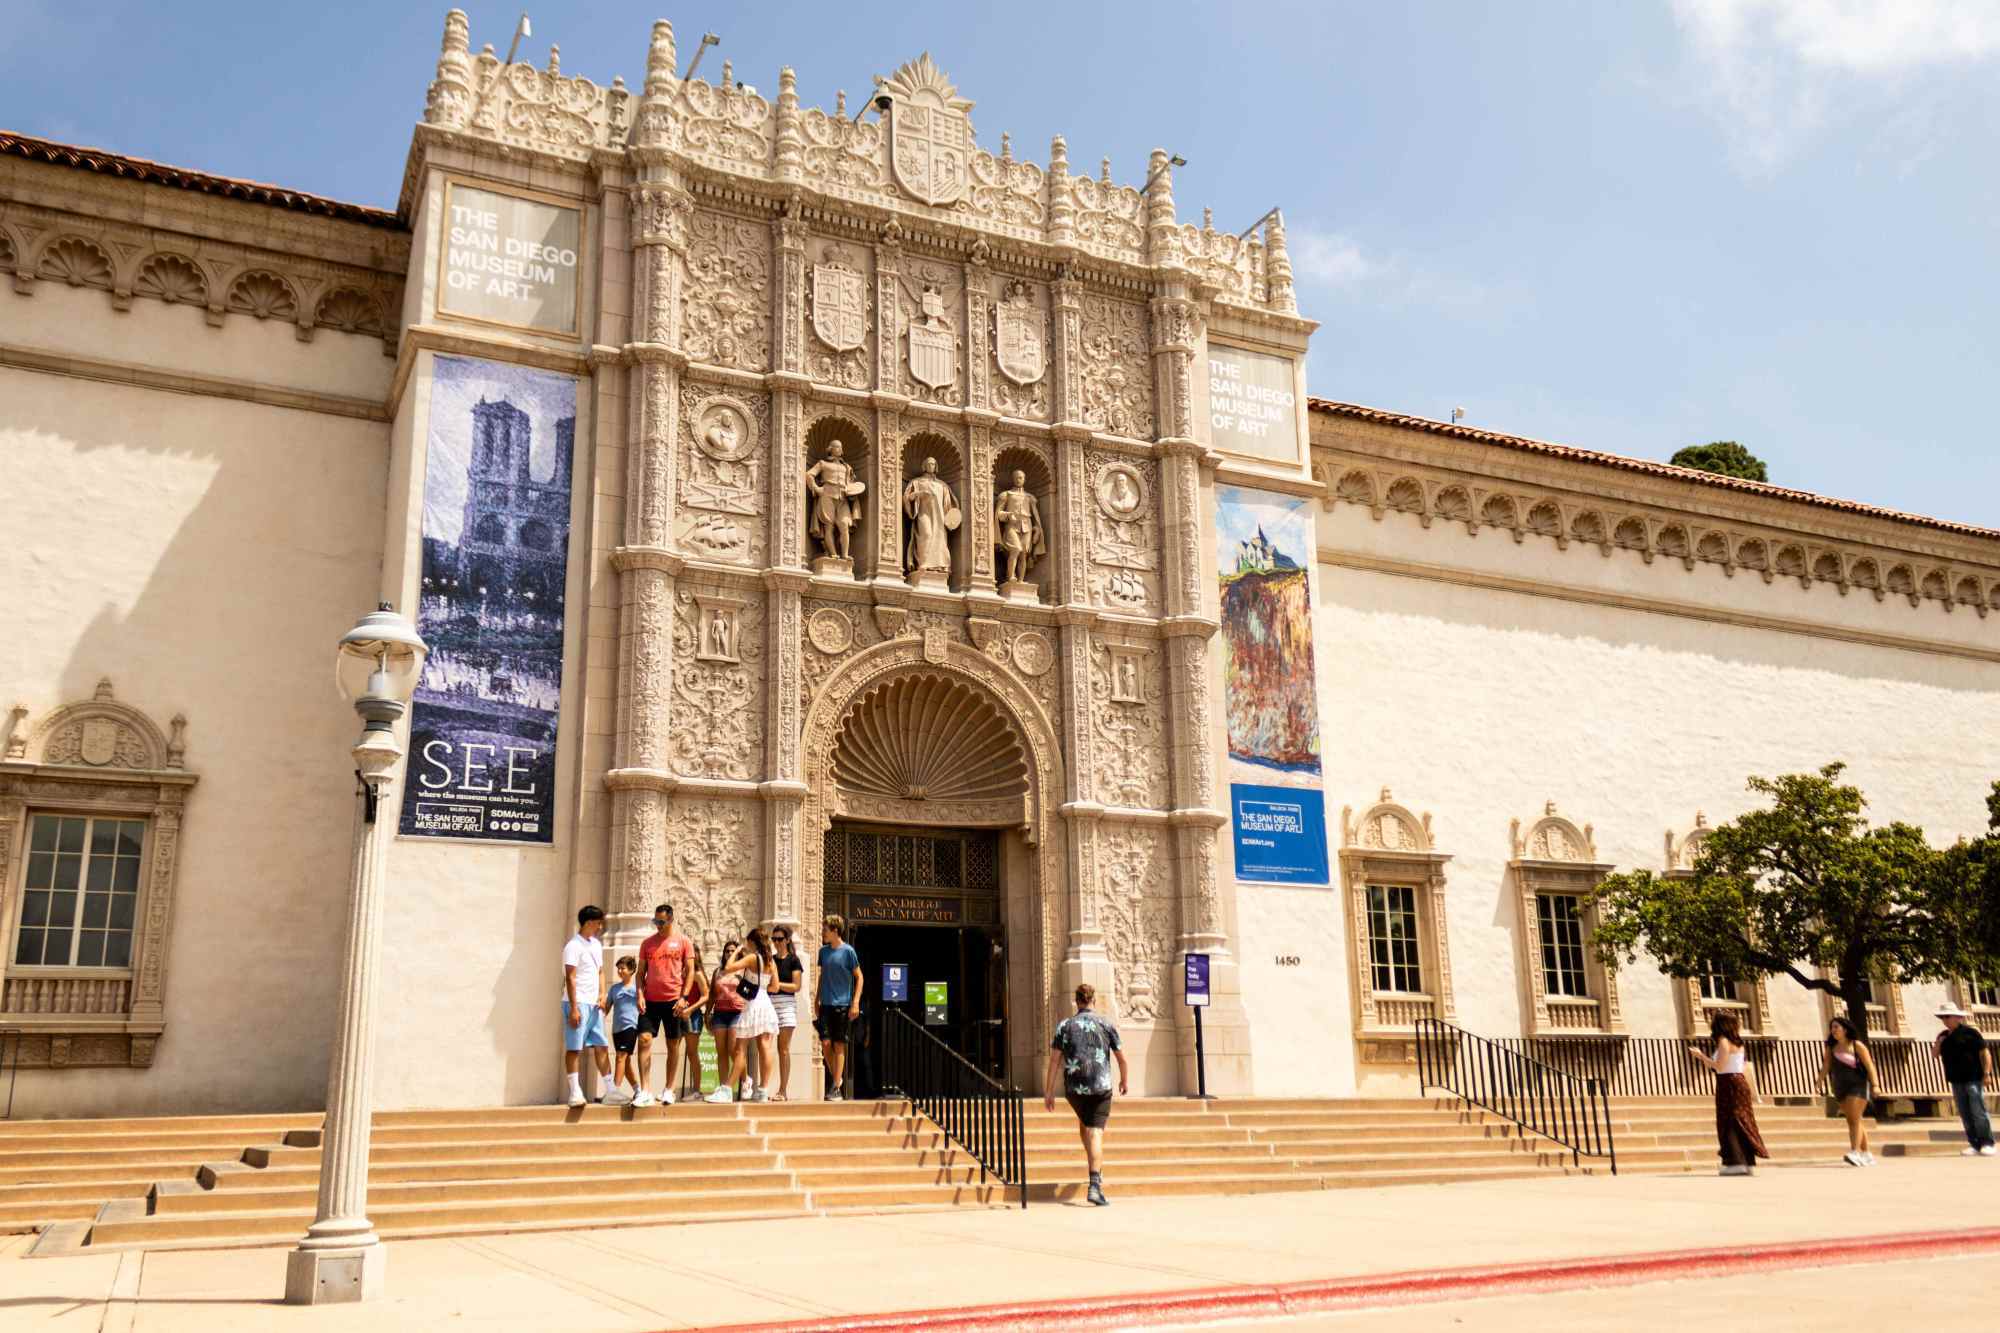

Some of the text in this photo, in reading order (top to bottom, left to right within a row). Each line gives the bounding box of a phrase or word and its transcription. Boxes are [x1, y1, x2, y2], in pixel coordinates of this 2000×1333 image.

[451, 205, 498, 230] THE
[450, 227, 577, 267] SAN DIEGO
[449, 249, 555, 285] MUSEUM
[448, 271, 534, 301] OF ART
[1209, 360, 1241, 378] THE
[1210, 378, 1295, 407] SAN DIEGO
[1211, 395, 1283, 422] MUSEUM
[1212, 414, 1269, 437] OF ART
[419, 740, 537, 794] SEE
[418, 790, 441, 798] where
[442, 791, 455, 799] the
[416, 813, 477, 824] THE SAN DIEGO
[490, 809, 540, 821] SDMArt.org
[1241, 813, 1296, 824] THE SAN DIEGO
[415, 821, 480, 832] MUSEUM OF ART
[1241, 821, 1299, 833] MUSEUM OF ART
[873, 897, 939, 909] SAN DIEGO
[856, 907, 954, 921] MUSEUM OF ART
[1274, 956, 1301, 967] 1450
